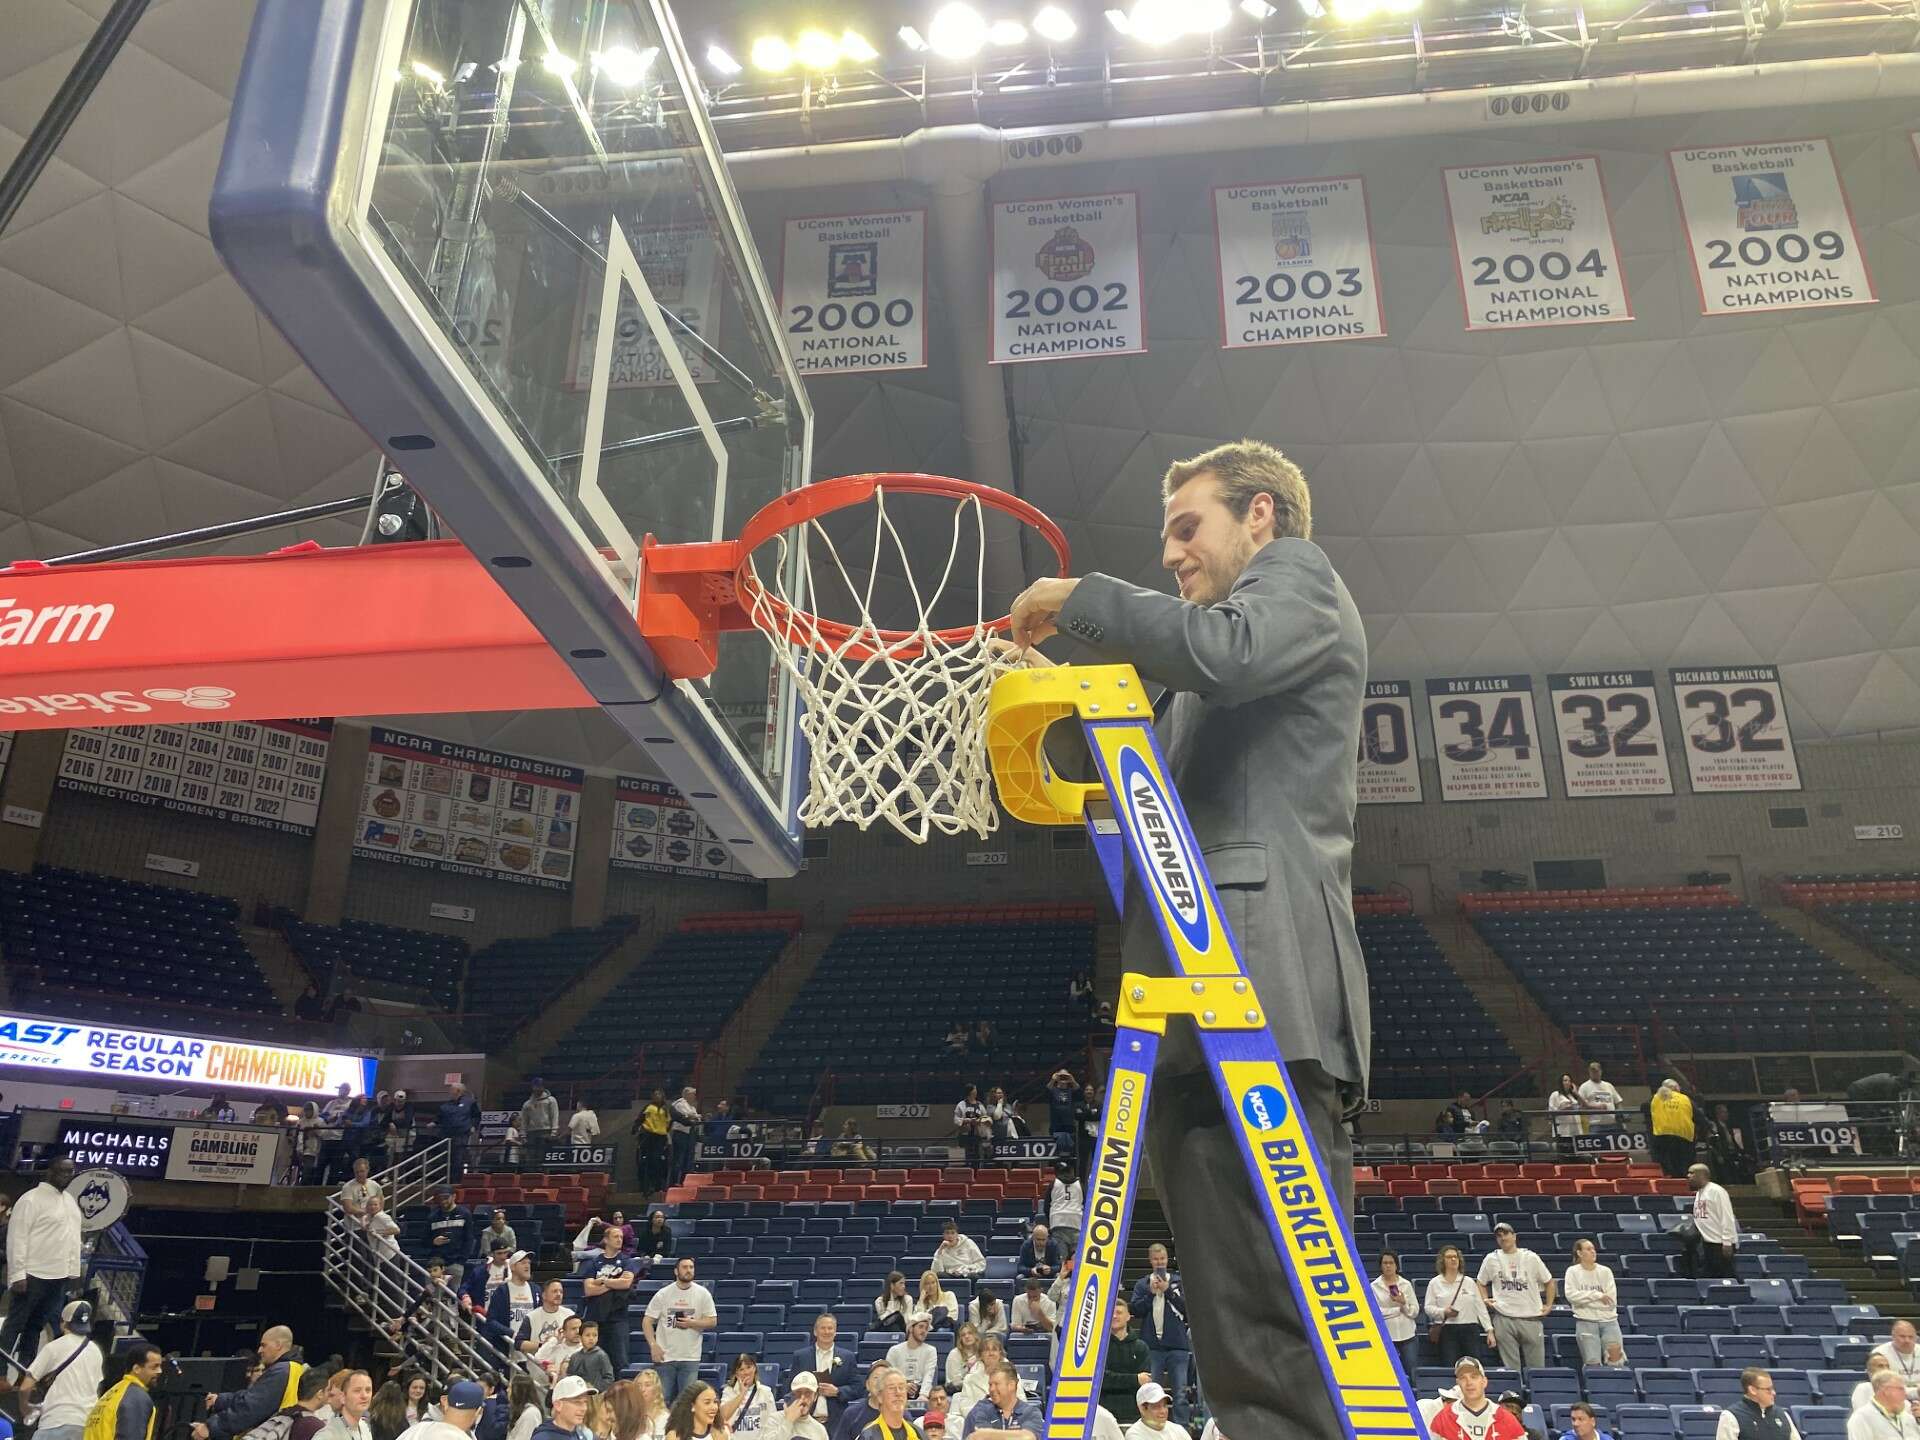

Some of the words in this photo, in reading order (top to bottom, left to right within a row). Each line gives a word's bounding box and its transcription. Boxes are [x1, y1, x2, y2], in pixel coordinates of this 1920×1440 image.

[1684, 149, 1737, 162] UConn
[1742, 142, 1815, 157] Women's
[1458, 167, 1509, 180] UConn
[1513, 161, 1584, 176] Women's
[1712, 158, 1794, 174] Basketball
[1228, 187, 1277, 200] UConn
[1280, 182, 1349, 196] Women's
[1484, 176, 1563, 192] Basketball
[1006, 201, 1053, 214] UConn
[1058, 196, 1124, 210] Women's
[1252, 197, 1328, 212] Basketball
[1491, 193, 1530, 204] NCAA
[798, 219, 844, 231] UConn
[848, 214, 912, 228] Women's
[1028, 212, 1102, 226] Basketball
[818, 228, 890, 243] Basketball
[1705, 231, 1845, 269] 2009
[1472, 249, 1608, 286] 2004
[1236, 268, 1363, 305] 2003
[1727, 268, 1839, 288] NATIONAL
[1005, 282, 1128, 319] 2002
[1490, 286, 1598, 305] NATIONAL
[1722, 286, 1853, 308] CHAMPIONS
[789, 299, 913, 334] 2000
[1250, 305, 1354, 323] NATIONAL
[1485, 303, 1610, 324] CHAMPIONS
[1018, 319, 1117, 337] NATIONAL
[1242, 322, 1365, 343] CHAMPIONS
[803, 335, 899, 351] NATIONAL
[1009, 335, 1126, 356] CHAMPIONS
[795, 352, 907, 370] CHAMPIONS
[1569, 675, 1599, 688] SWIN
[1604, 674, 1633, 685] CASH
[1675, 671, 1720, 682] RICHARD
[1722, 669, 1774, 681] HAMILTON
[1370, 684, 1399, 695] LOBO
[1449, 681, 1469, 692] RAY
[1474, 679, 1509, 690] ALLEN
[1438, 697, 1531, 762] 34
[1561, 693, 1658, 758] 32
[1684, 688, 1785, 753] 32
[232, 723, 256, 741] 1997
[1357, 702, 1409, 765] 0
[153, 728, 183, 747] 2003
[190, 737, 218, 757] 2004
[262, 754, 288, 772] 2007
[384, 732, 432, 752] NCAA
[442, 744, 572, 778] CHAMPIONSHIP
[70, 734, 102, 755] 2009
[109, 743, 140, 763] 2010
[149, 752, 177, 771] 2011
[187, 760, 214, 778] 2012
[223, 768, 249, 786] 2013
[257, 775, 283, 793] 2014
[291, 782, 316, 800] 2015
[439, 758, 477, 772] FINAL
[484, 765, 518, 779] FOUR
[64, 758, 94, 778] 2016
[105, 766, 133, 785] 2017
[144, 775, 171, 794] 2018
[182, 782, 209, 801] 2019
[219, 790, 244, 808] 2021
[254, 797, 279, 815] 2022
[620, 779, 660, 793] NCAA
[1447, 783, 1491, 791] NUMBER
[1495, 781, 1540, 790] RETIRED
[1571, 779, 1616, 787] NUMBER
[1620, 777, 1665, 786] RETIRED
[1696, 774, 1741, 783] NUMBER
[1746, 773, 1792, 781] RETIRED
[1371, 786, 1415, 794] RETIRED
[58, 778, 159, 805] CONNECTICUT
[164, 800, 227, 820] WOMEN'S
[231, 813, 313, 837] BASKETBALL
[1877, 827, 1900, 837] 210
[984, 854, 1006, 863] 207
[1133, 786, 1196, 915] WERNER
[353, 847, 436, 869] CONNECTICUT
[441, 862, 493, 879] WOMEN'S
[498, 871, 567, 890] BASKETBALL
[87, 1030, 205, 1060] REGULAR
[90, 1052, 193, 1077] SEASON
[205, 1044, 328, 1089] CHAMPIONS
[879, 1107, 896, 1116] SEC
[900, 1105, 929, 1117] 207
[1115, 1078, 1136, 1133] PODIO
[1246, 1090, 1273, 1132] NCAA
[63, 1129, 170, 1151] MICHAELS
[192, 1130, 261, 1142] PROBLEM
[1577, 1138, 1602, 1148] SEC
[1606, 1133, 1647, 1149] 108
[1779, 1131, 1805, 1142] SEC
[1808, 1127, 1852, 1145] 109
[190, 1139, 258, 1156] GAMBLING
[545, 1152, 565, 1161] SEC
[571, 1149, 604, 1163] 106
[704, 1145, 725, 1154] SEC
[731, 1143, 764, 1157] 107
[996, 1145, 1017, 1154] SEC
[1023, 1142, 1057, 1157] 107
[68, 1149, 160, 1168] JEWELERS
[188, 1153, 257, 1163] HELPLINE
[1064, 1186, 1072, 1200] 5
[1086, 1135, 1131, 1268] PODIUM
[1261, 1138, 1376, 1361] BASKETBALL
[1077, 1289, 1096, 1357] WERNER
